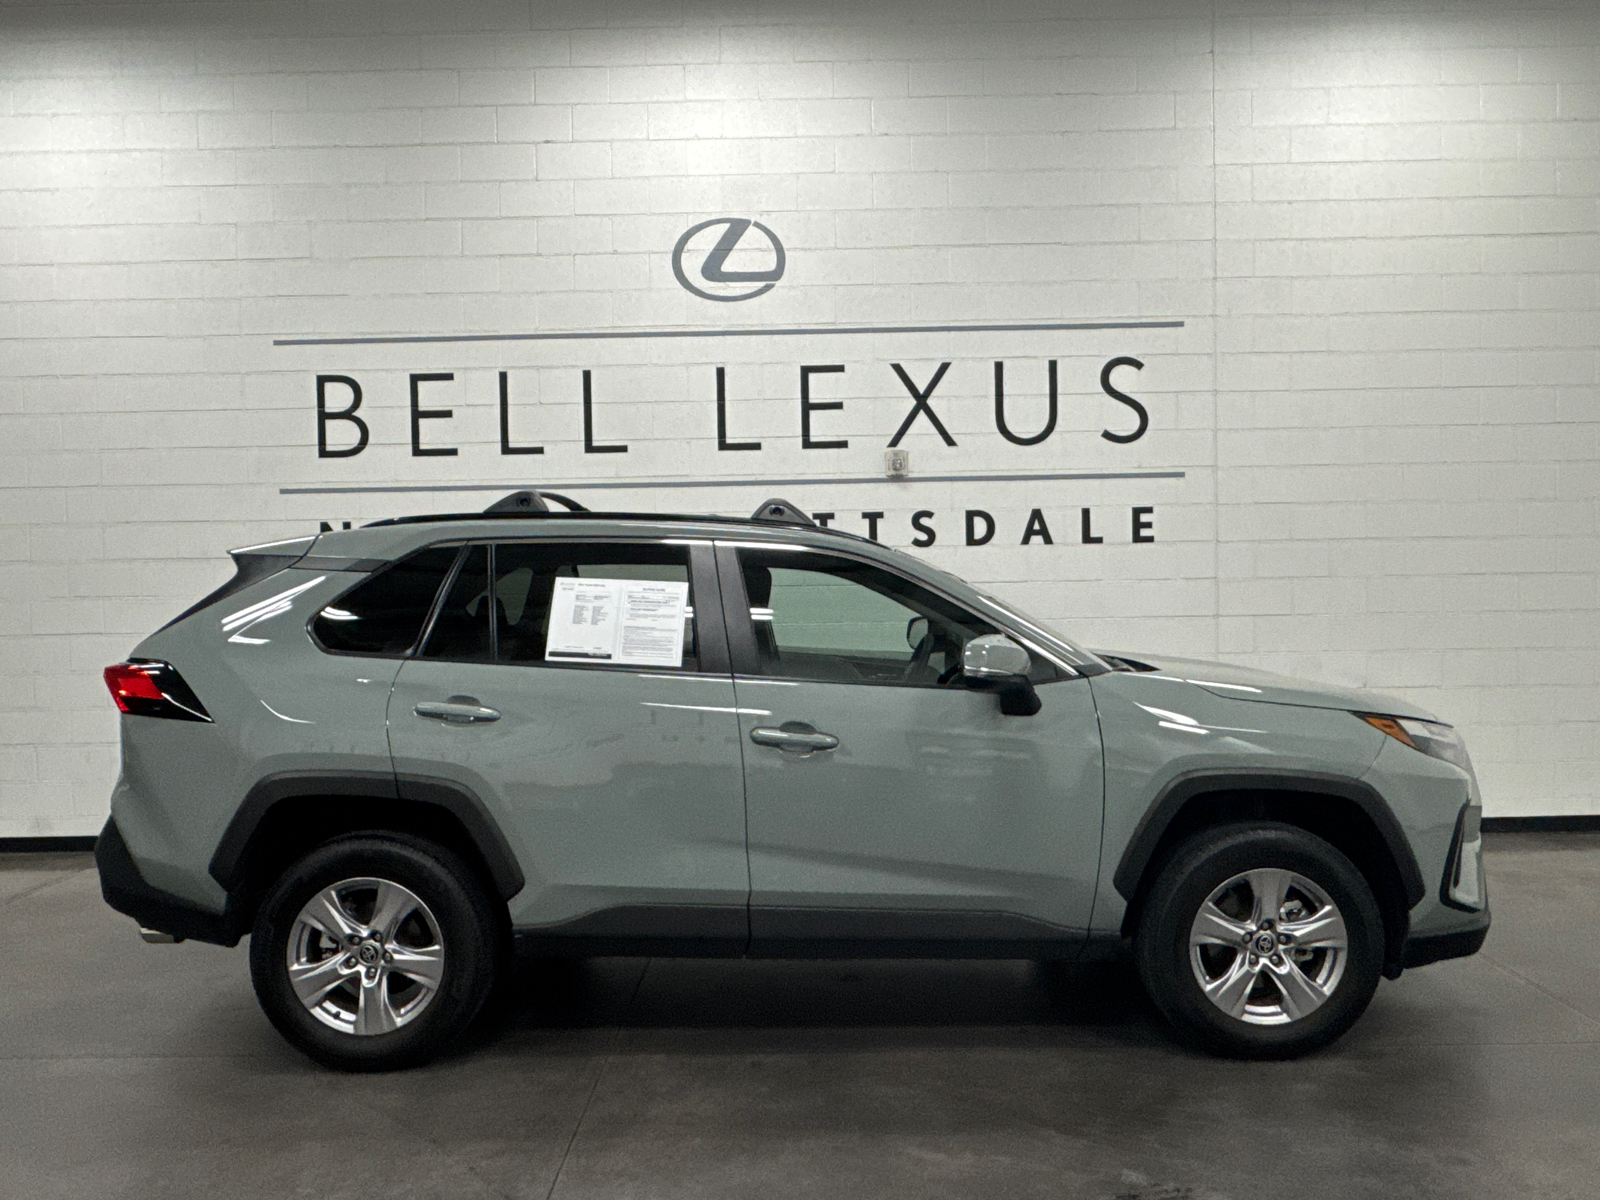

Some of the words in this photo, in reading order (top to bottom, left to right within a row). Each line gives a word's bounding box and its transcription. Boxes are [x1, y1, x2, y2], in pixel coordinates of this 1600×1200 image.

[316, 369, 628, 459] BELL
[716, 356, 1149, 451] LEXUS
[812, 506, 1155, 547] TTSDALE
